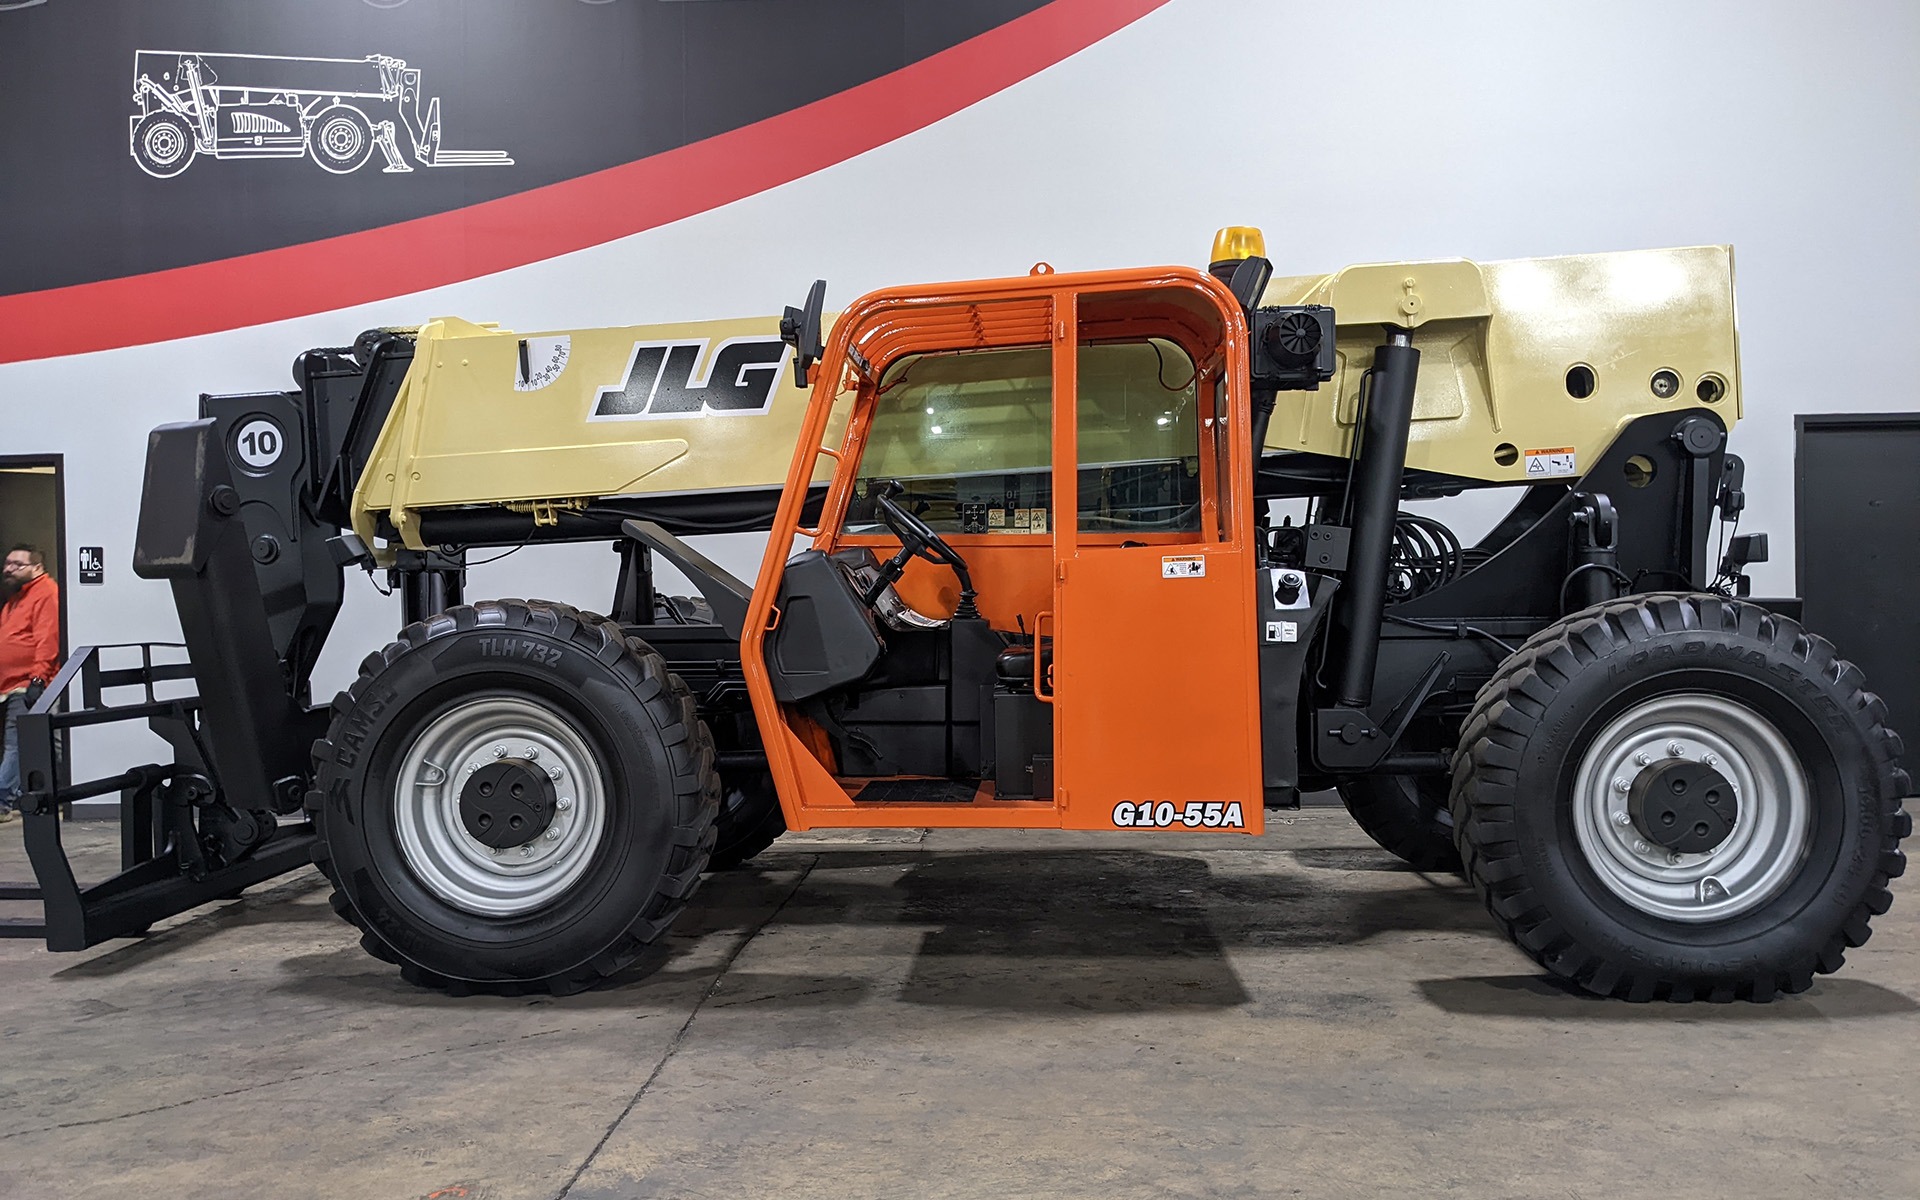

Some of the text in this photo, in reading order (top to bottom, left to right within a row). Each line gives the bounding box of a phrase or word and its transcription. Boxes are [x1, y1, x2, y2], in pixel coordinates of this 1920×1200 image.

[535, 372, 542, 380] 20
[545, 365, 552, 373] 40
[552, 364, 560, 372] 50
[543, 373, 551, 381] 30
[594, 341, 788, 416] JLG
[242, 431, 277, 456] 10
[479, 638, 563, 668] TLH 732
[1112, 800, 1245, 828] G10-55A
